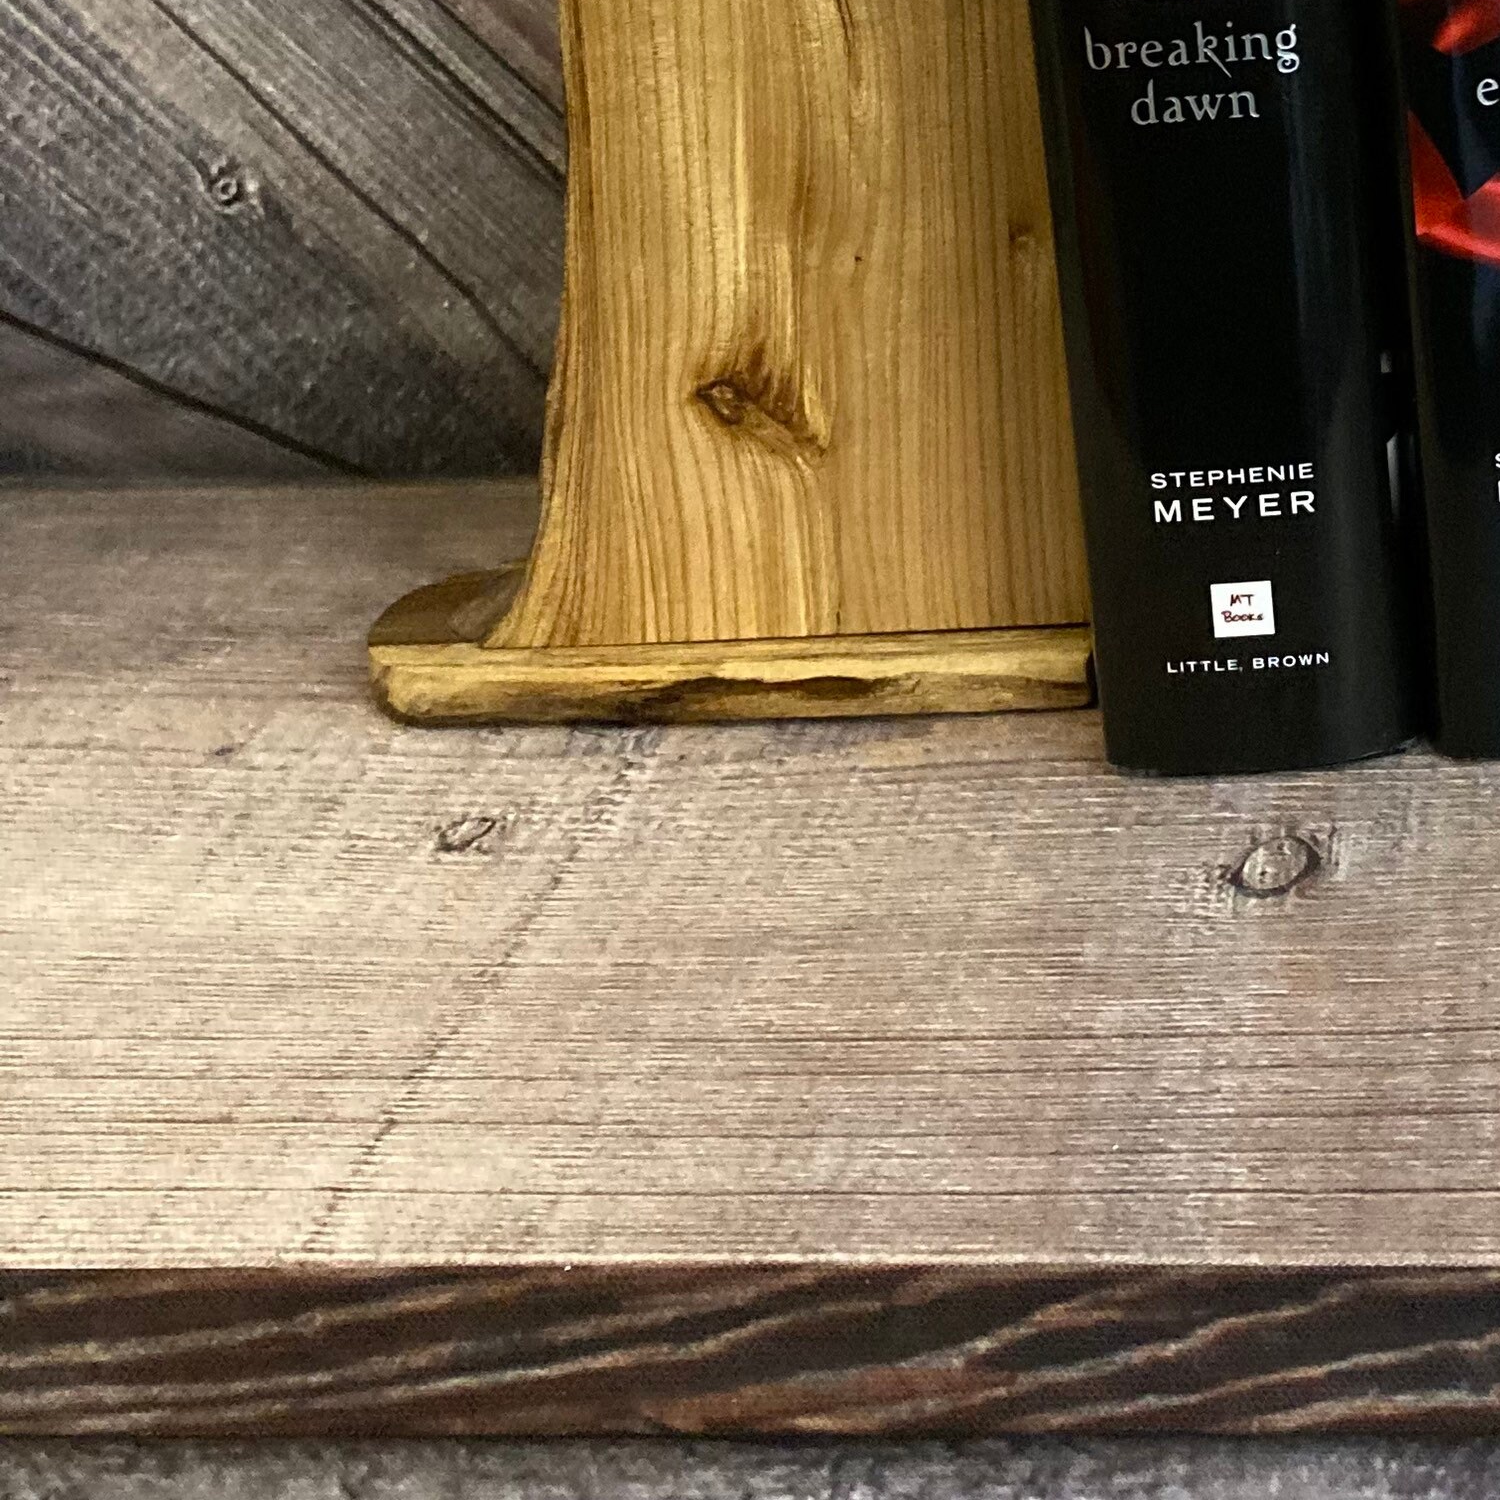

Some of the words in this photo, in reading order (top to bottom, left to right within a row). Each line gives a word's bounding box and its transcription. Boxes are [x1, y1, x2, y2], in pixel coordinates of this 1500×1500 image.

[1084, 21, 1300, 78] breaking
[1130, 78, 1260, 126] dawn
[1150, 462, 1315, 489] STEPHENIE
[1154, 490, 1316, 523] MEYER
[1230, 594, 1255, 607] MT
[1167, 658, 1243, 674] LITTLE,
[1252, 652, 1330, 669] BROWN
